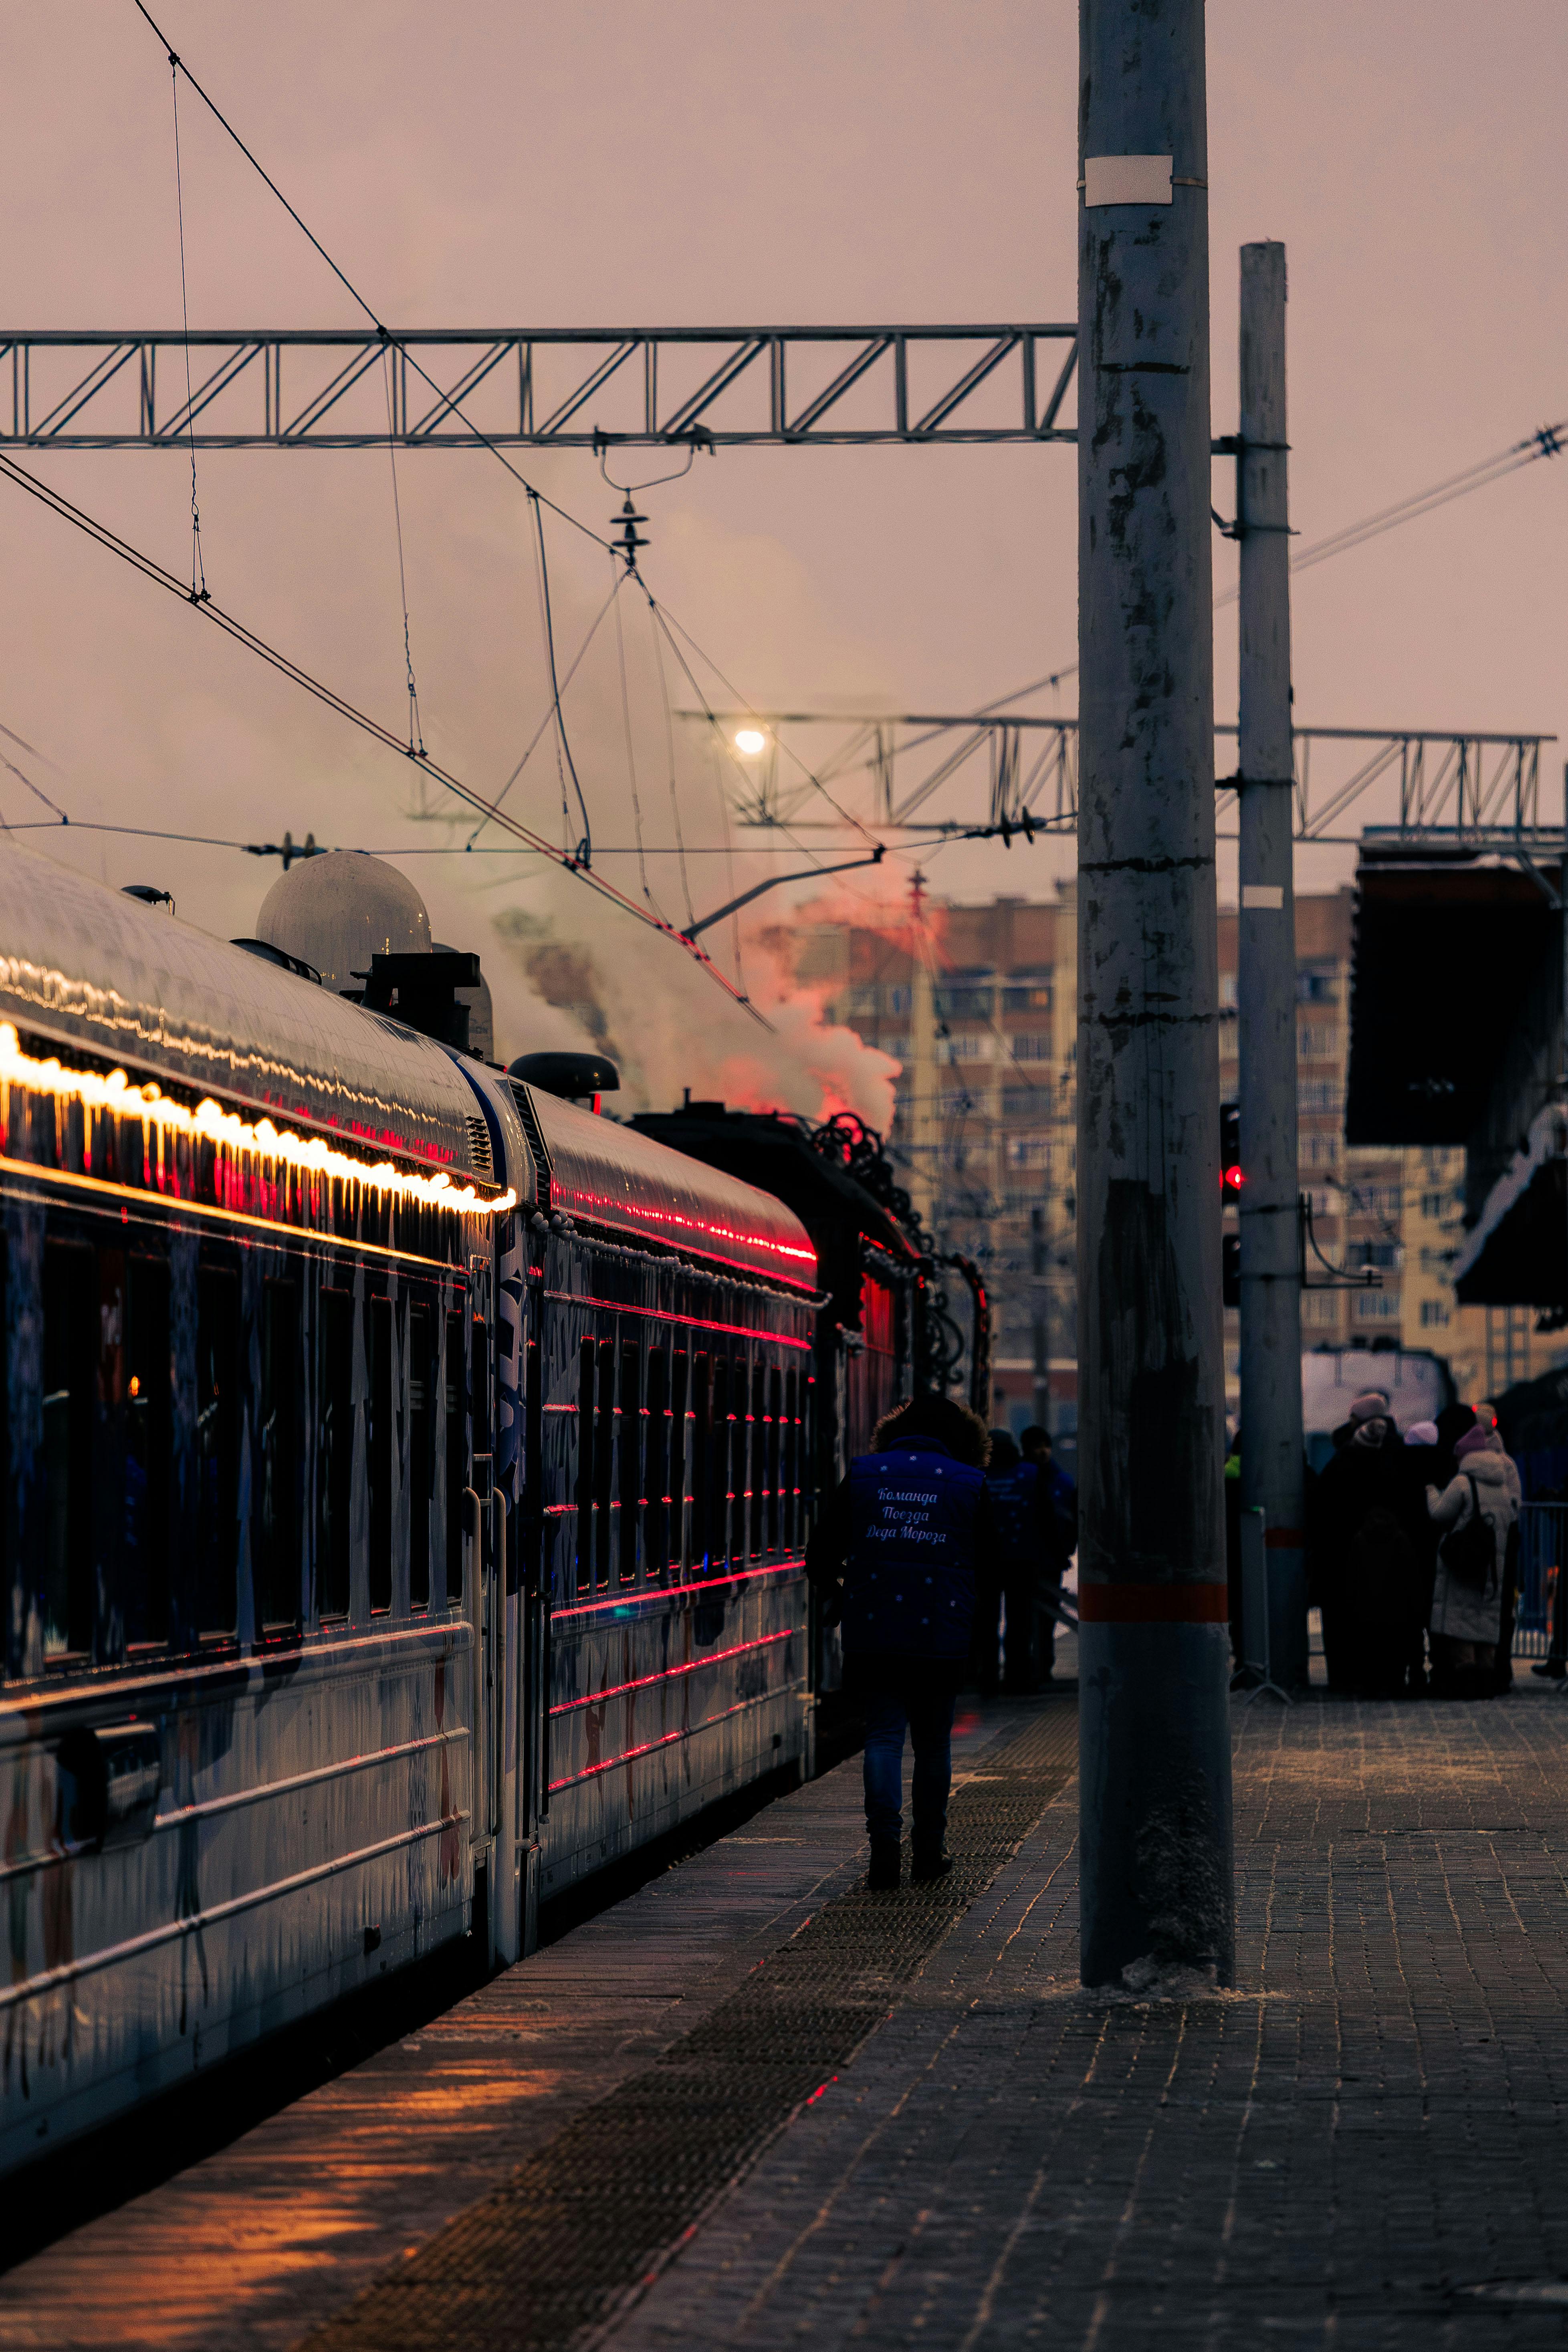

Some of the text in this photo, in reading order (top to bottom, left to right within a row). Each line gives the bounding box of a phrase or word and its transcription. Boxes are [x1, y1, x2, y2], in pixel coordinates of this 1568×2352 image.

[878, 1488, 937, 1506] Команда
[882, 1506, 929, 1523] Поезда
[866, 1524, 946, 1545] Деда Мороза
